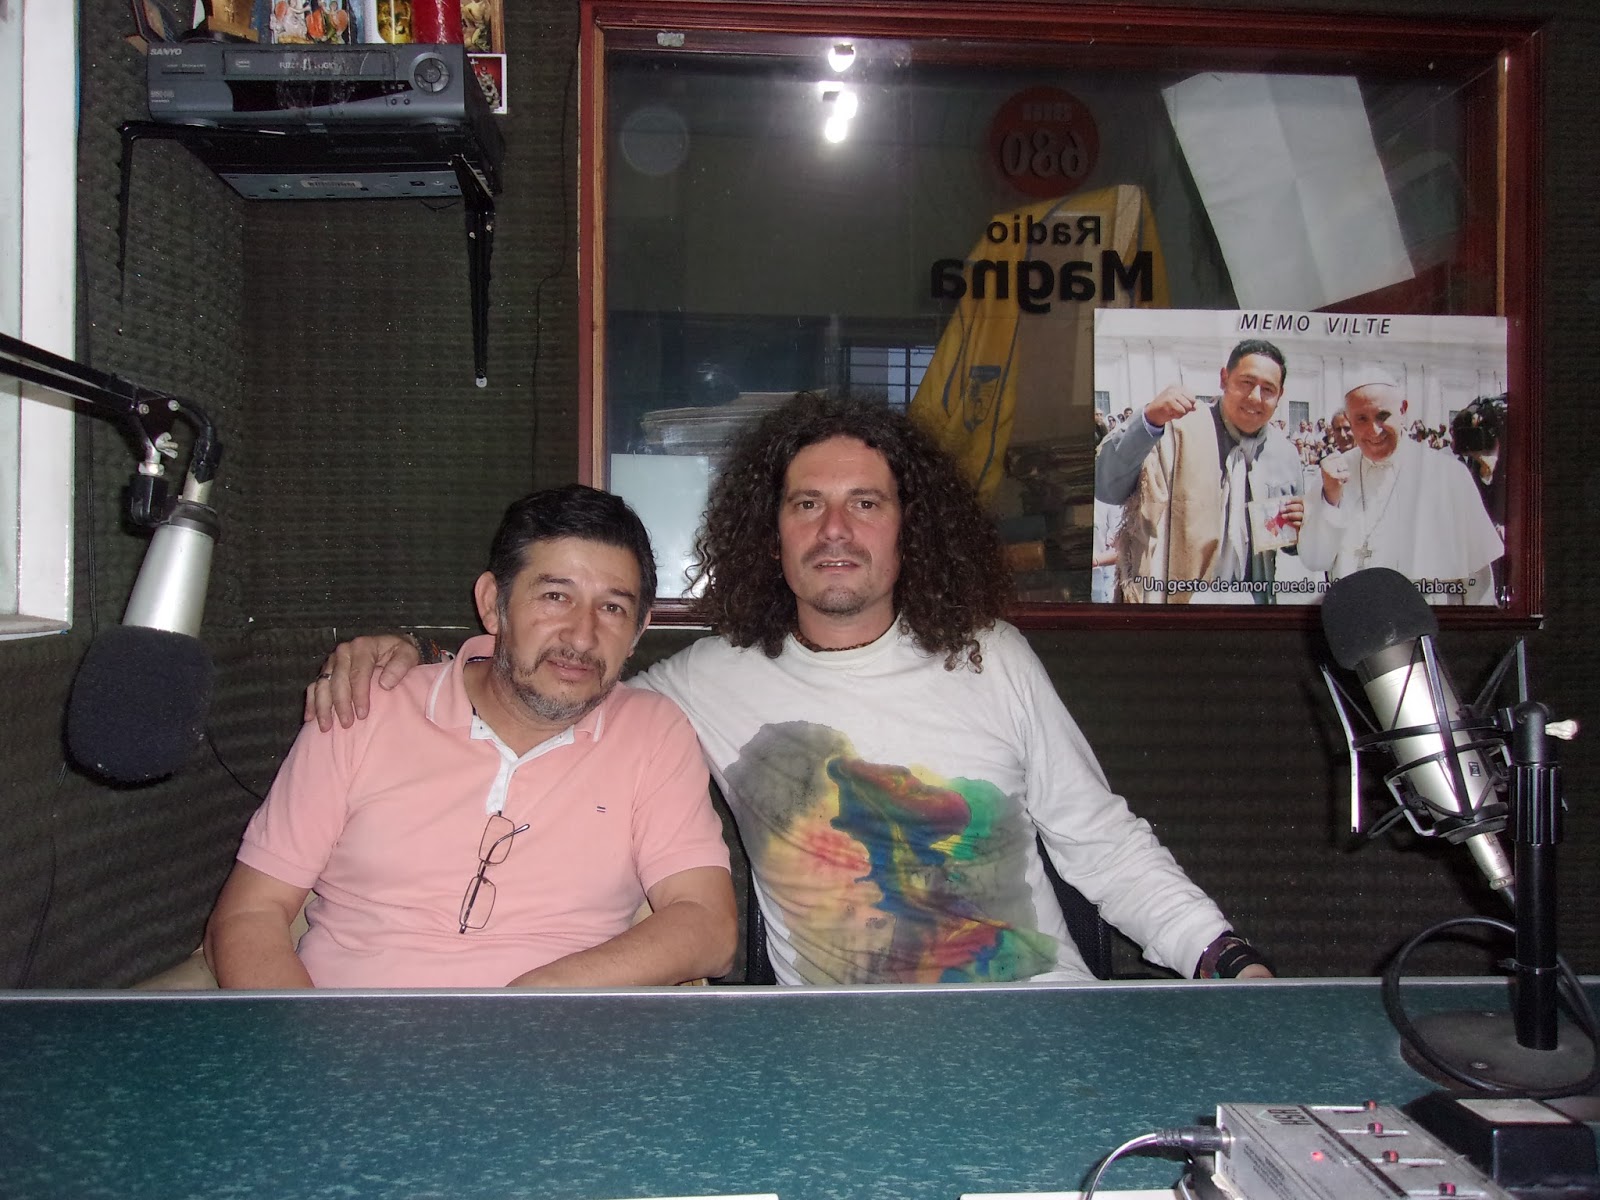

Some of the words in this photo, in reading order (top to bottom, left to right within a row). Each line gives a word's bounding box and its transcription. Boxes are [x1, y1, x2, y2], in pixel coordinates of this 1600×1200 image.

[150, 48, 183, 56] SANYO
[1240, 313, 1310, 332] MEMO
[1328, 317, 1391, 334] VILTE
[1167, 579, 1207, 595] gesto
[1210, 578, 1229, 593] de
[1231, 581, 1268, 593] amor
[1271, 579, 1316, 596] puede
